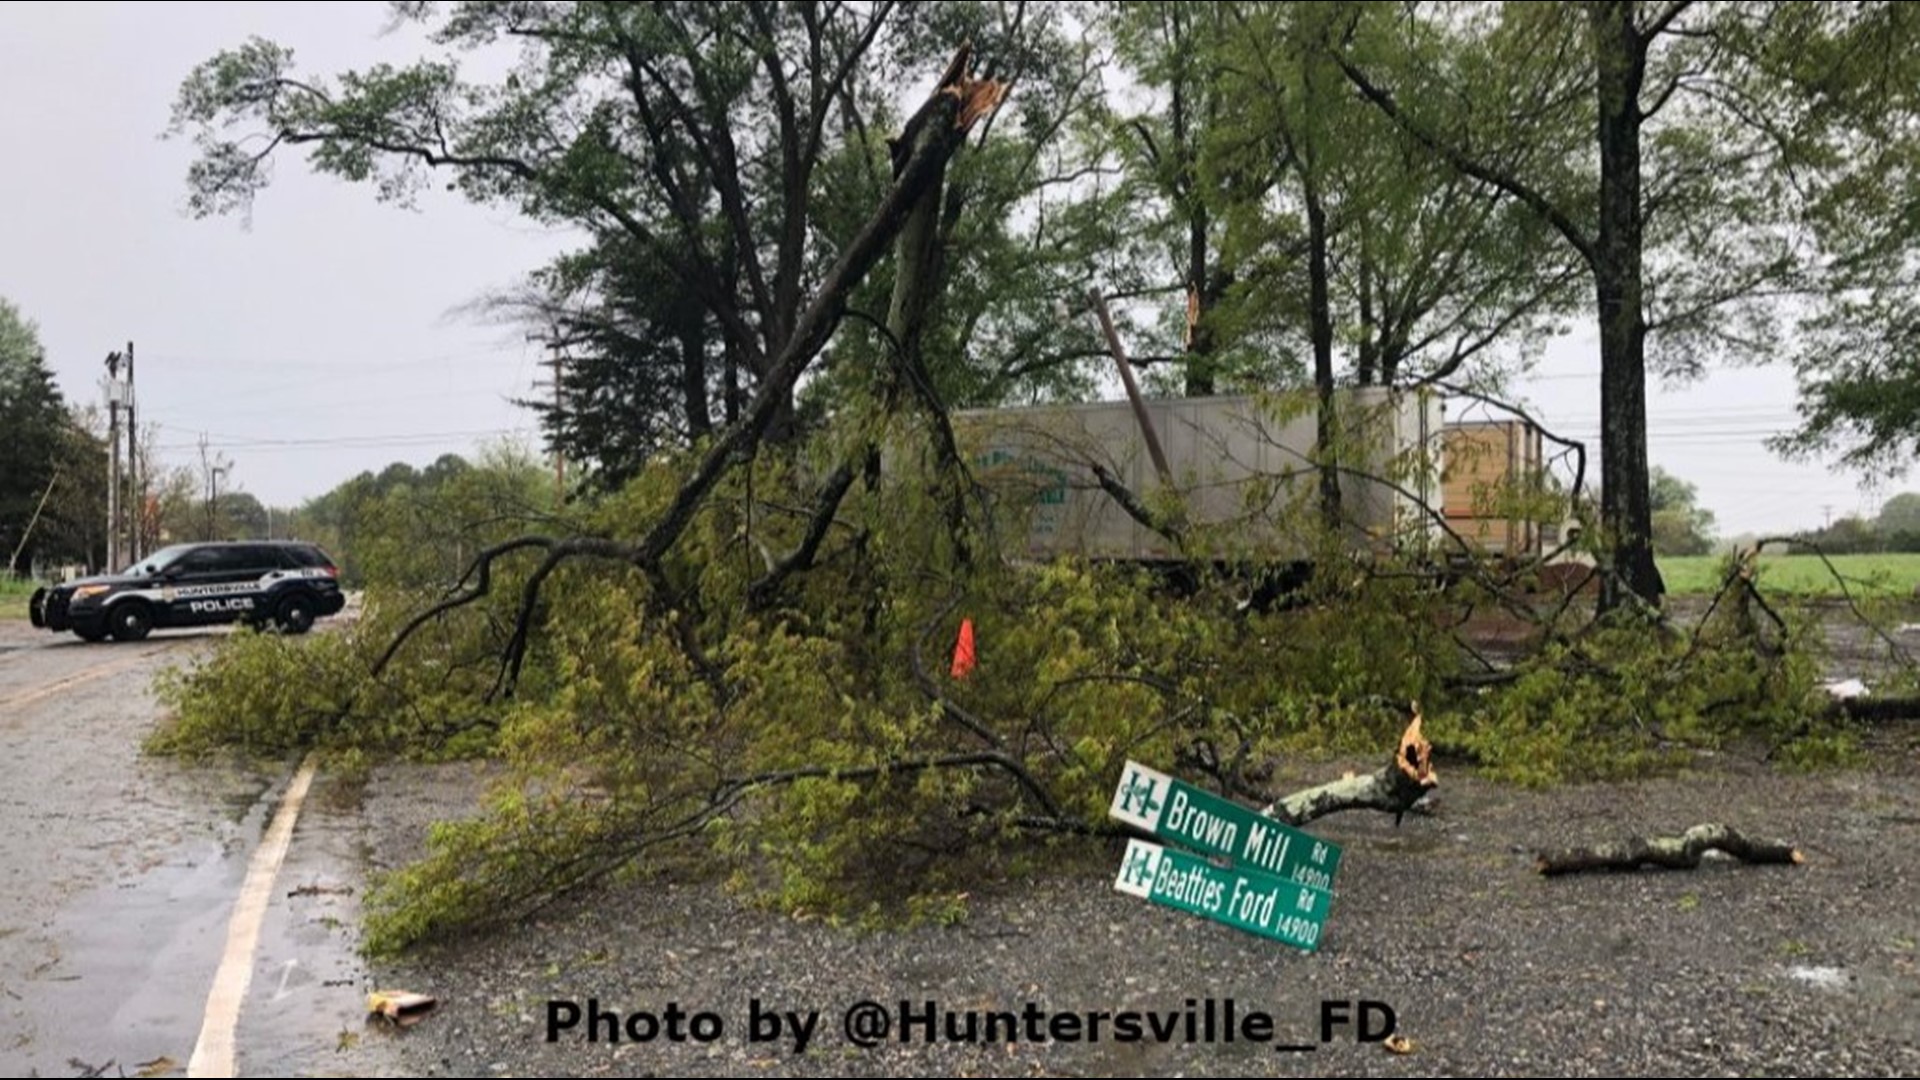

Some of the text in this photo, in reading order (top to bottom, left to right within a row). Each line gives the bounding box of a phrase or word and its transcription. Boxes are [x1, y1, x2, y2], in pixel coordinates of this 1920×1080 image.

[176, 582, 261, 597] HUNTERSVILLE
[190, 597, 255, 613] POLICE
[1166, 789, 1238, 854] Brown
[1242, 820, 1291, 874] Mill
[1311, 841, 1328, 866] Rd
[1291, 863, 1330, 889] 14900
[1154, 856, 1225, 913] Beatties
[1227, 876, 1279, 928] Ford
[1296, 888, 1315, 912] Rd
[1275, 913, 1319, 945] 14900
